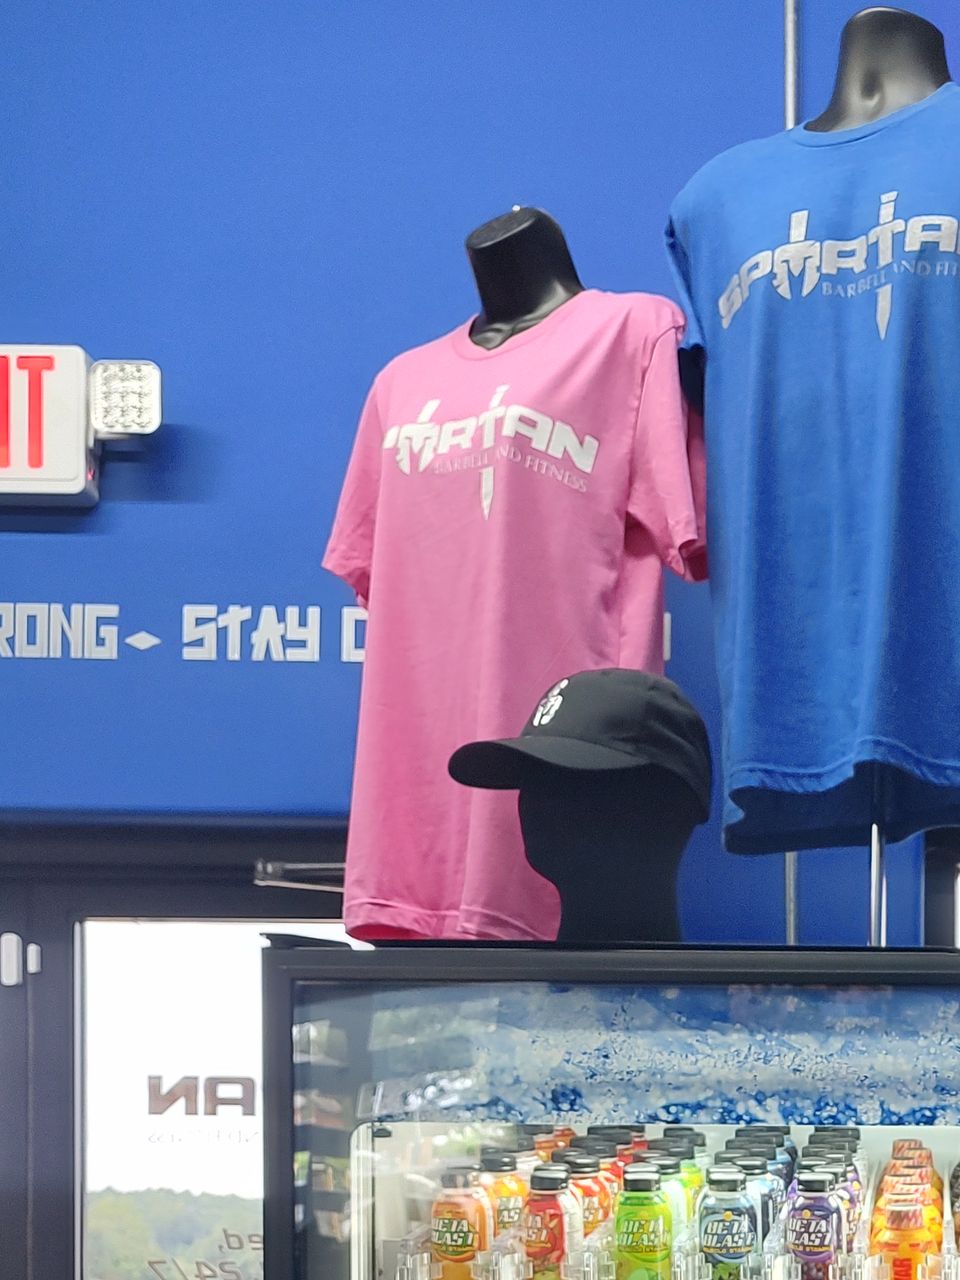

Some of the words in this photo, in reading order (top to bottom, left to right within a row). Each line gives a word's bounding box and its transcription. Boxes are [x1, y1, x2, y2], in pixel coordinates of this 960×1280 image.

[822, 271, 886, 298] BARBELL
[525, 456, 589, 493] FITNESS
[182, 604, 321, 662] STAY
[707, 1219, 748, 1233] BETA
